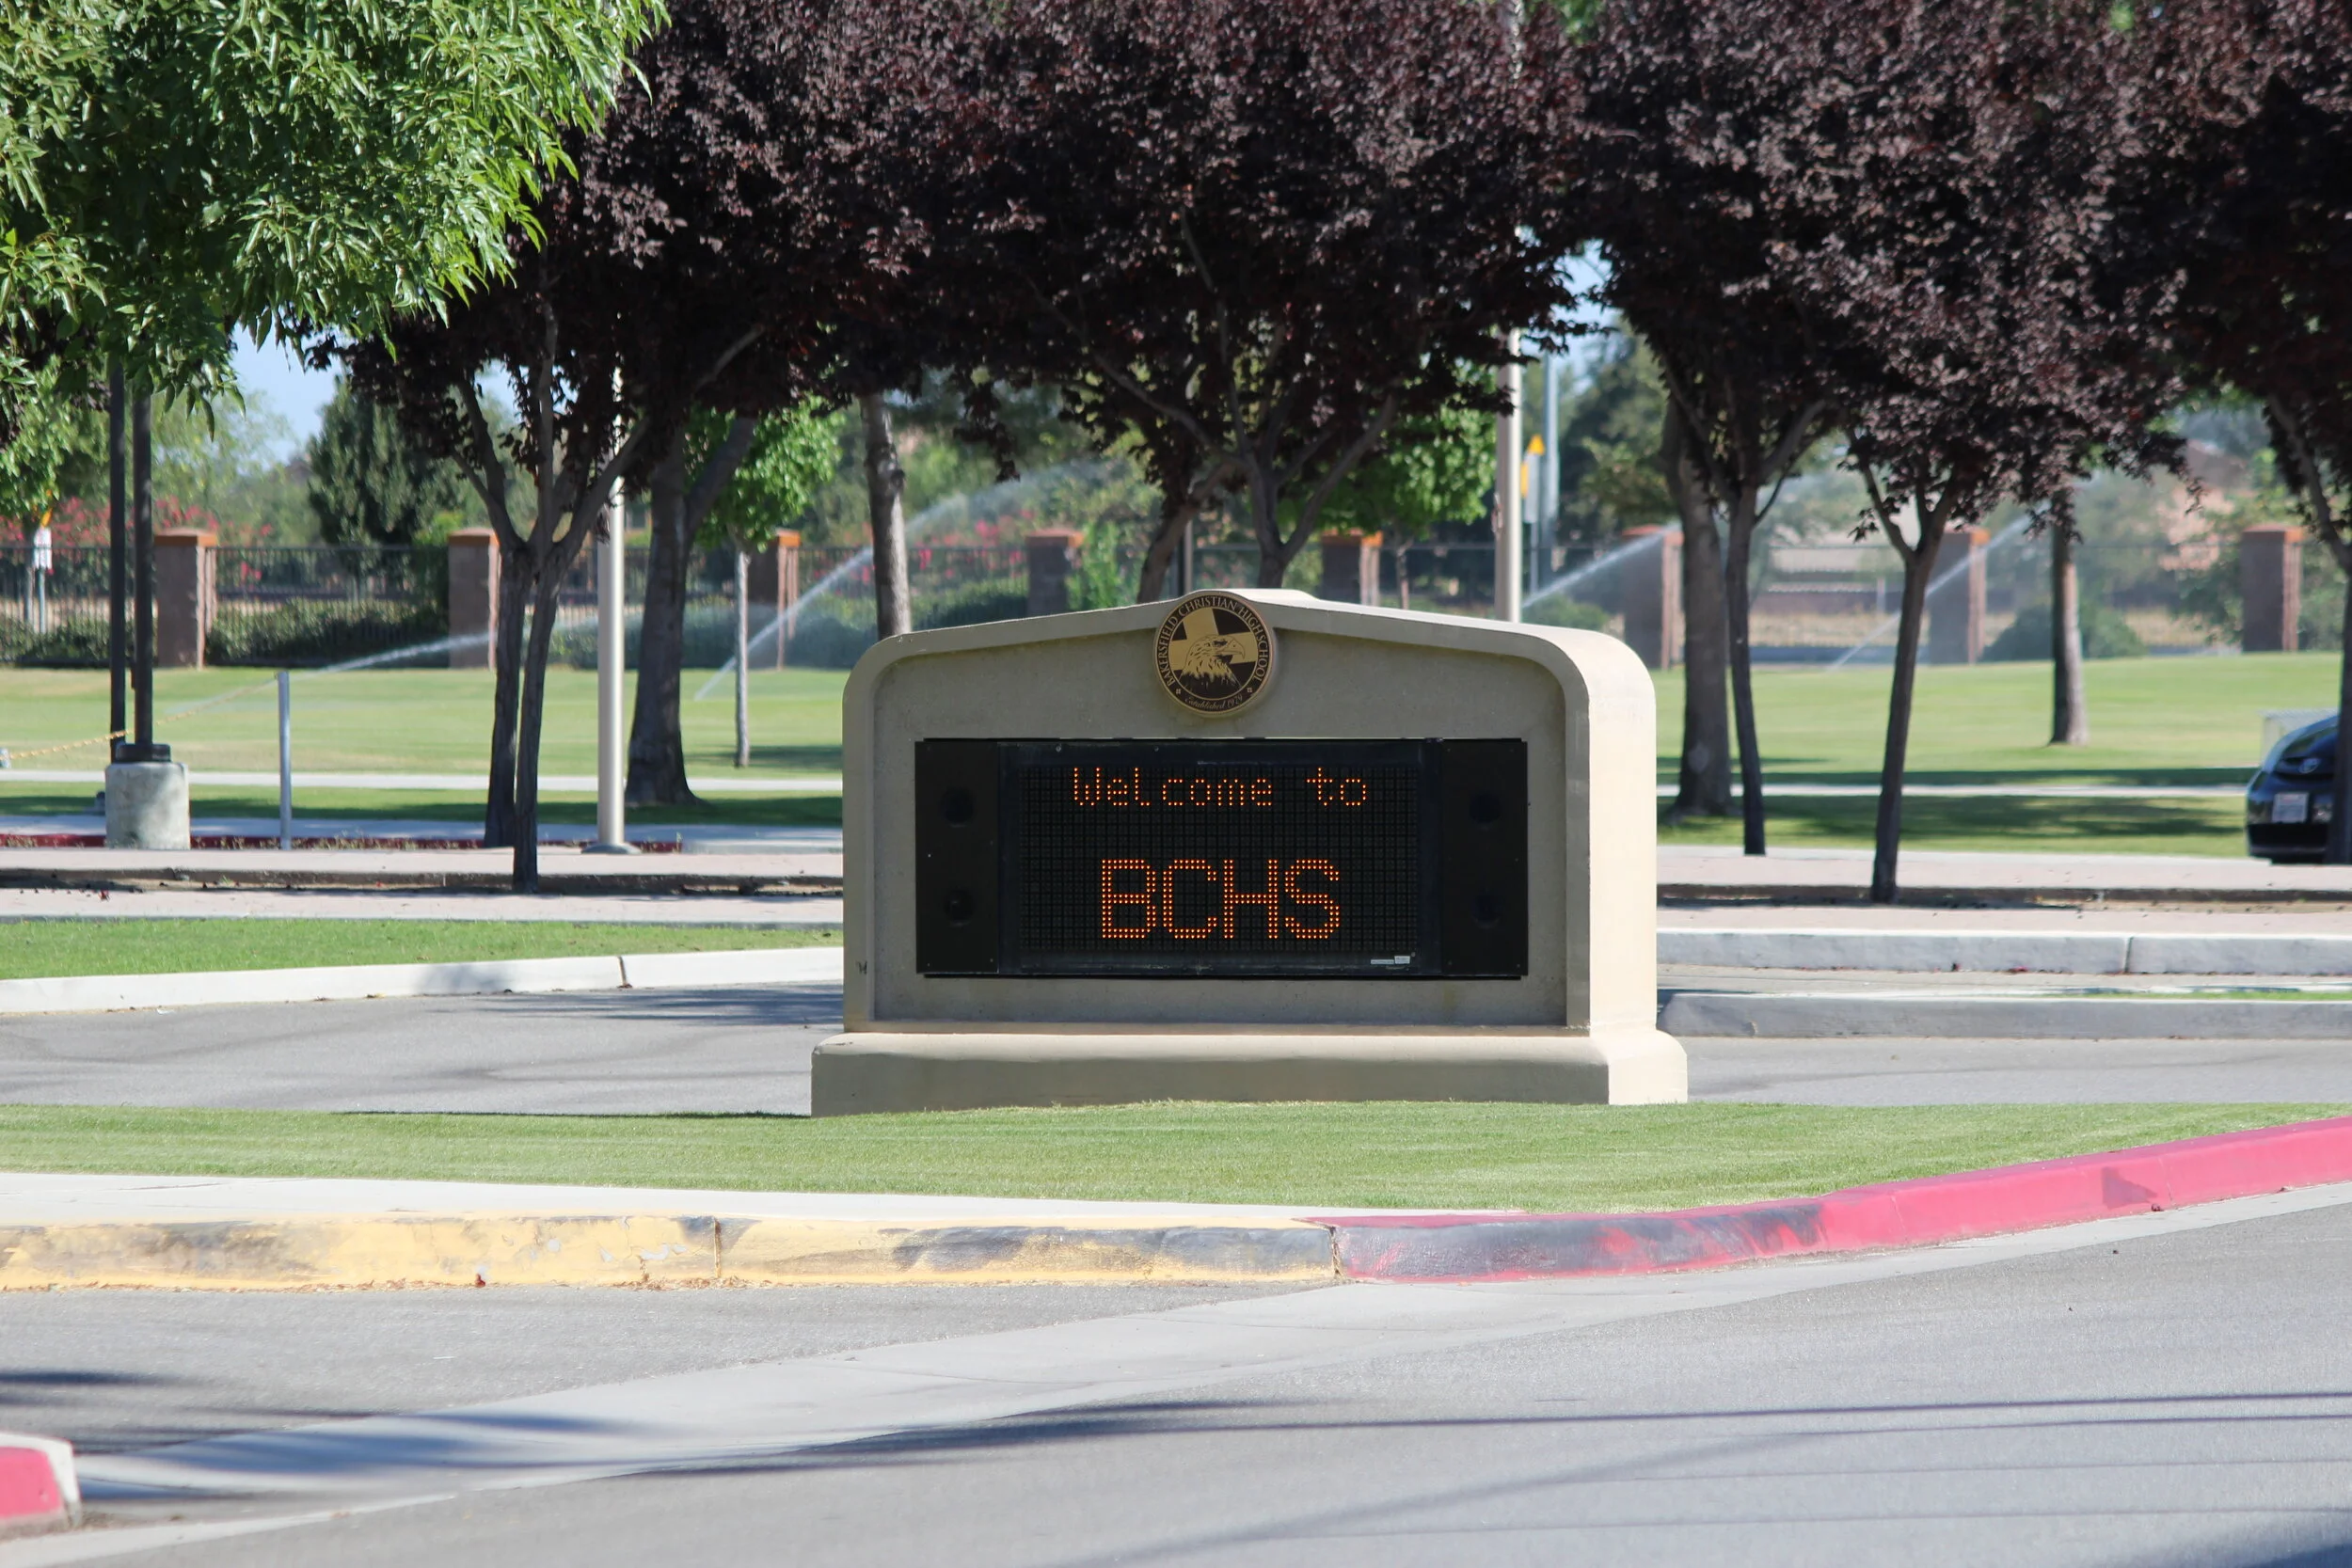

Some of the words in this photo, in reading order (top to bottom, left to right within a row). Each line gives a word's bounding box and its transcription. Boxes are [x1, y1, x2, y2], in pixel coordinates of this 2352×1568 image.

[1157, 616, 1179, 687] BAKERSFIELD
[1178, 595, 1238, 617] CHRISTIAN
[1238, 606, 1264, 636] HIGH
[1254, 634, 1269, 682] SCHOOL
[1185, 696, 1226, 710] Established
[1074, 768, 1272, 806] Welcome
[1307, 768, 1366, 806] to
[1102, 859, 1340, 939] BCHS
